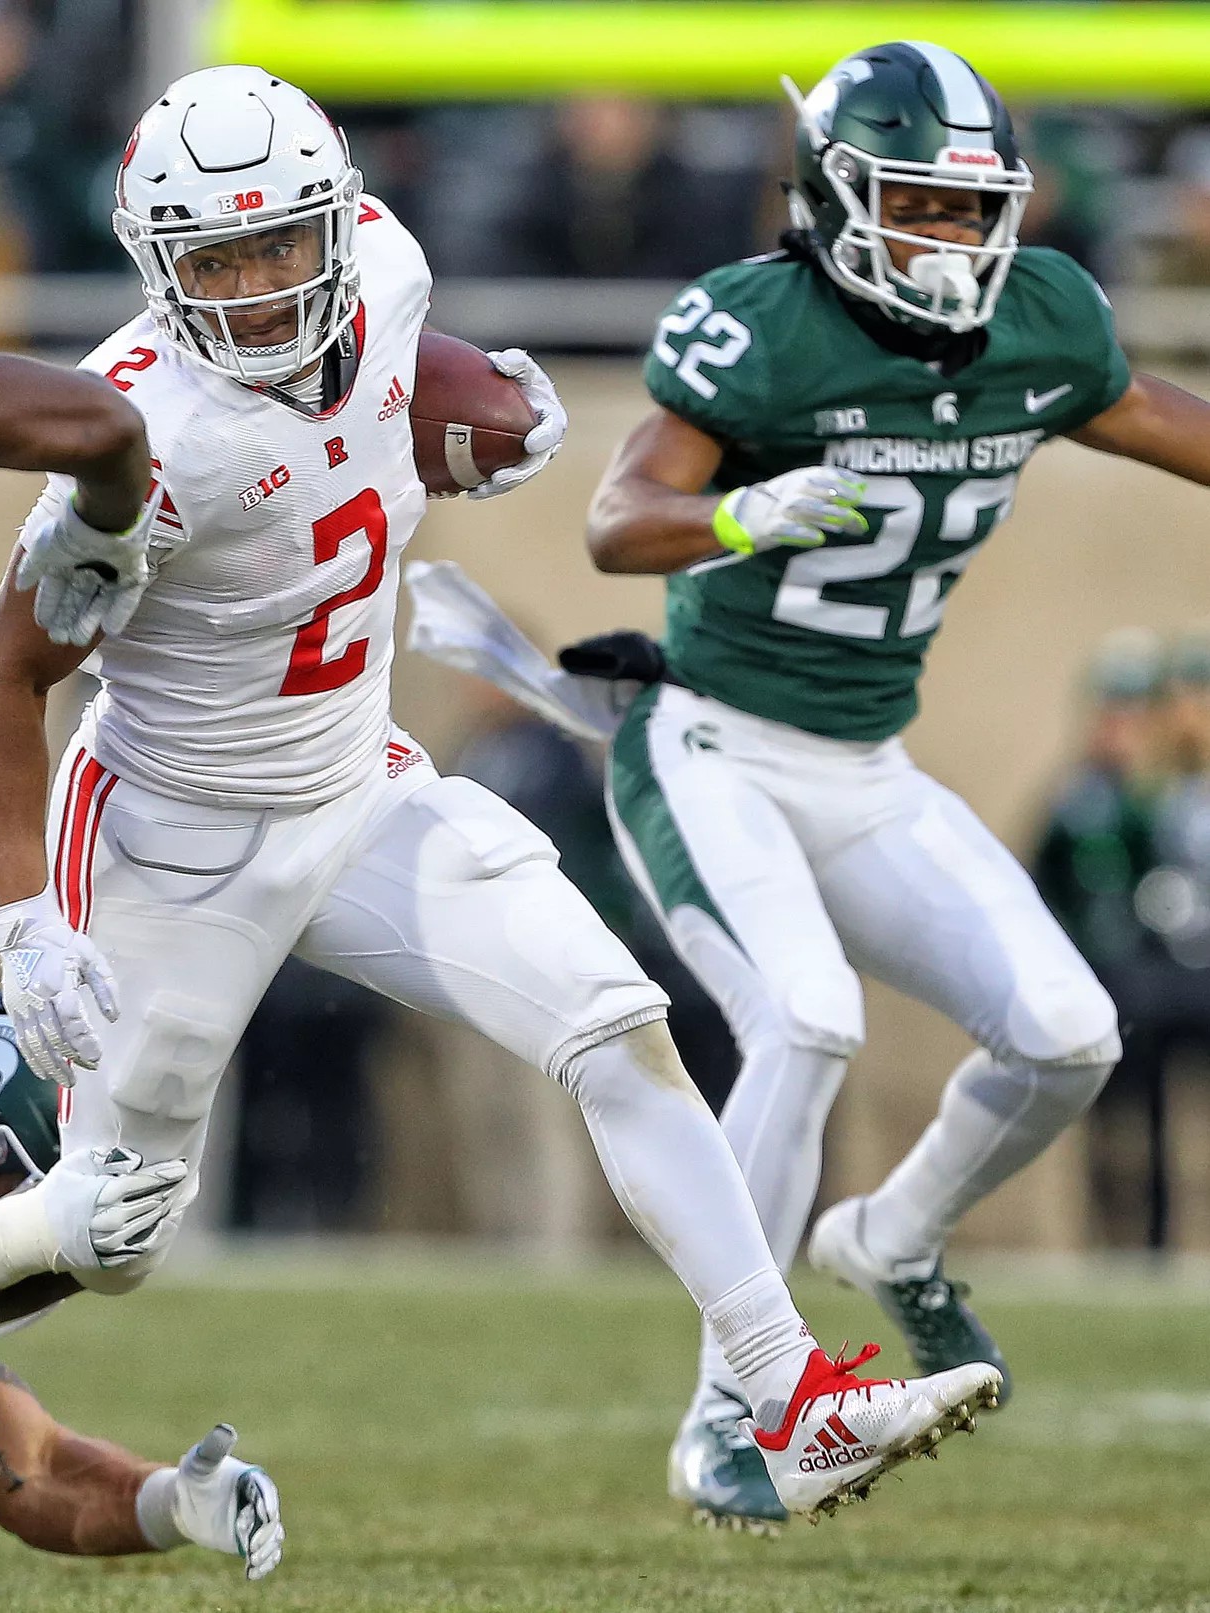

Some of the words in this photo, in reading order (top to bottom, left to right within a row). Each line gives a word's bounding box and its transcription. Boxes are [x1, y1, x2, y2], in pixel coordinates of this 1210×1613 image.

[653, 286, 751, 399] 22
[104, 346, 158, 392] 2
[324, 436, 349, 469] R
[823, 436, 969, 472] MICHIGAN
[279, 487, 388, 696] 2
